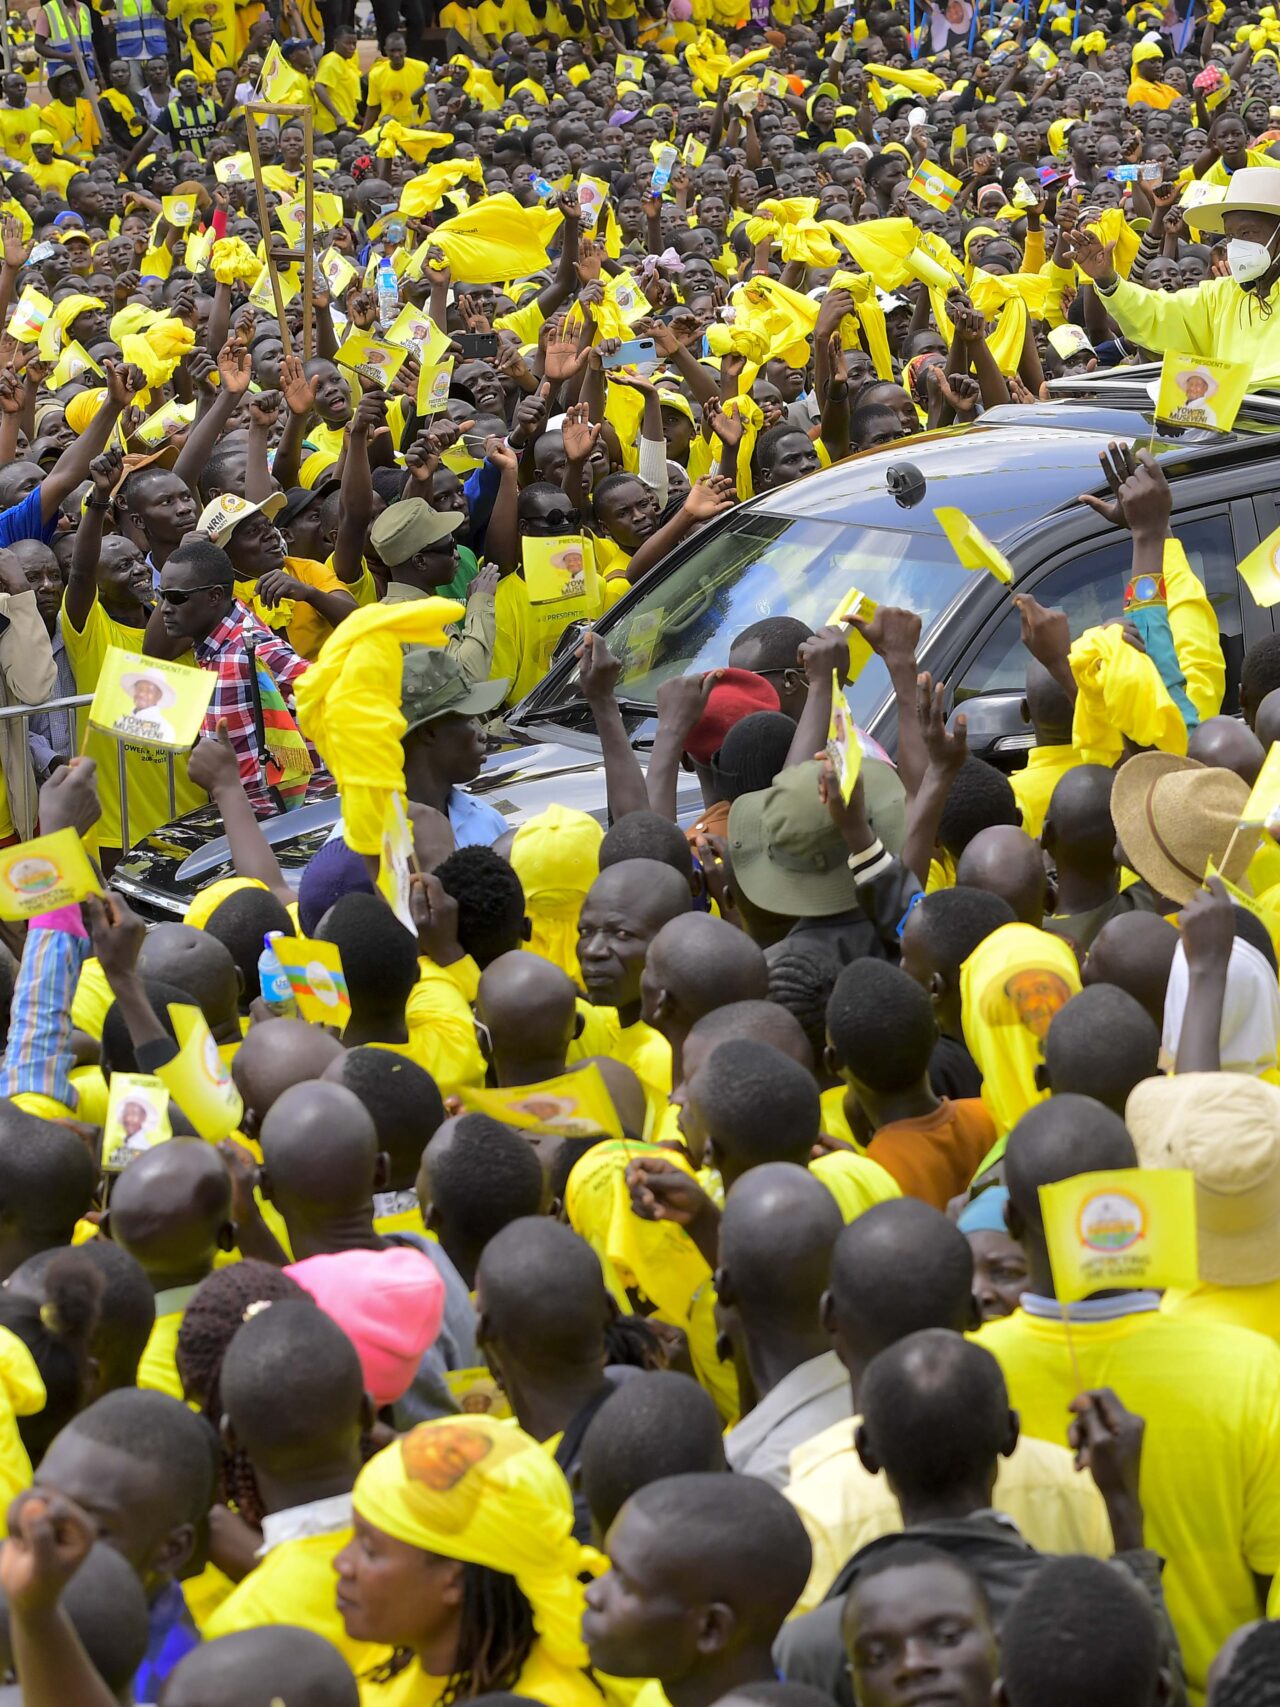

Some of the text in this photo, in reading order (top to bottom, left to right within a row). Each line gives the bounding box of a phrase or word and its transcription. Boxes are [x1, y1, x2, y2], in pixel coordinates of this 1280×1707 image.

[179, 125, 214, 137] ETIHAD
[1190, 358, 1223, 369] PRESIDENT
[1169, 412, 1207, 423] MUSEVENI
[207, 511, 226, 533] NRM
[547, 611, 578, 621] PRESIDENT
[122, 714, 161, 730] YOWERI
[112, 721, 164, 740] MUSEVENI
